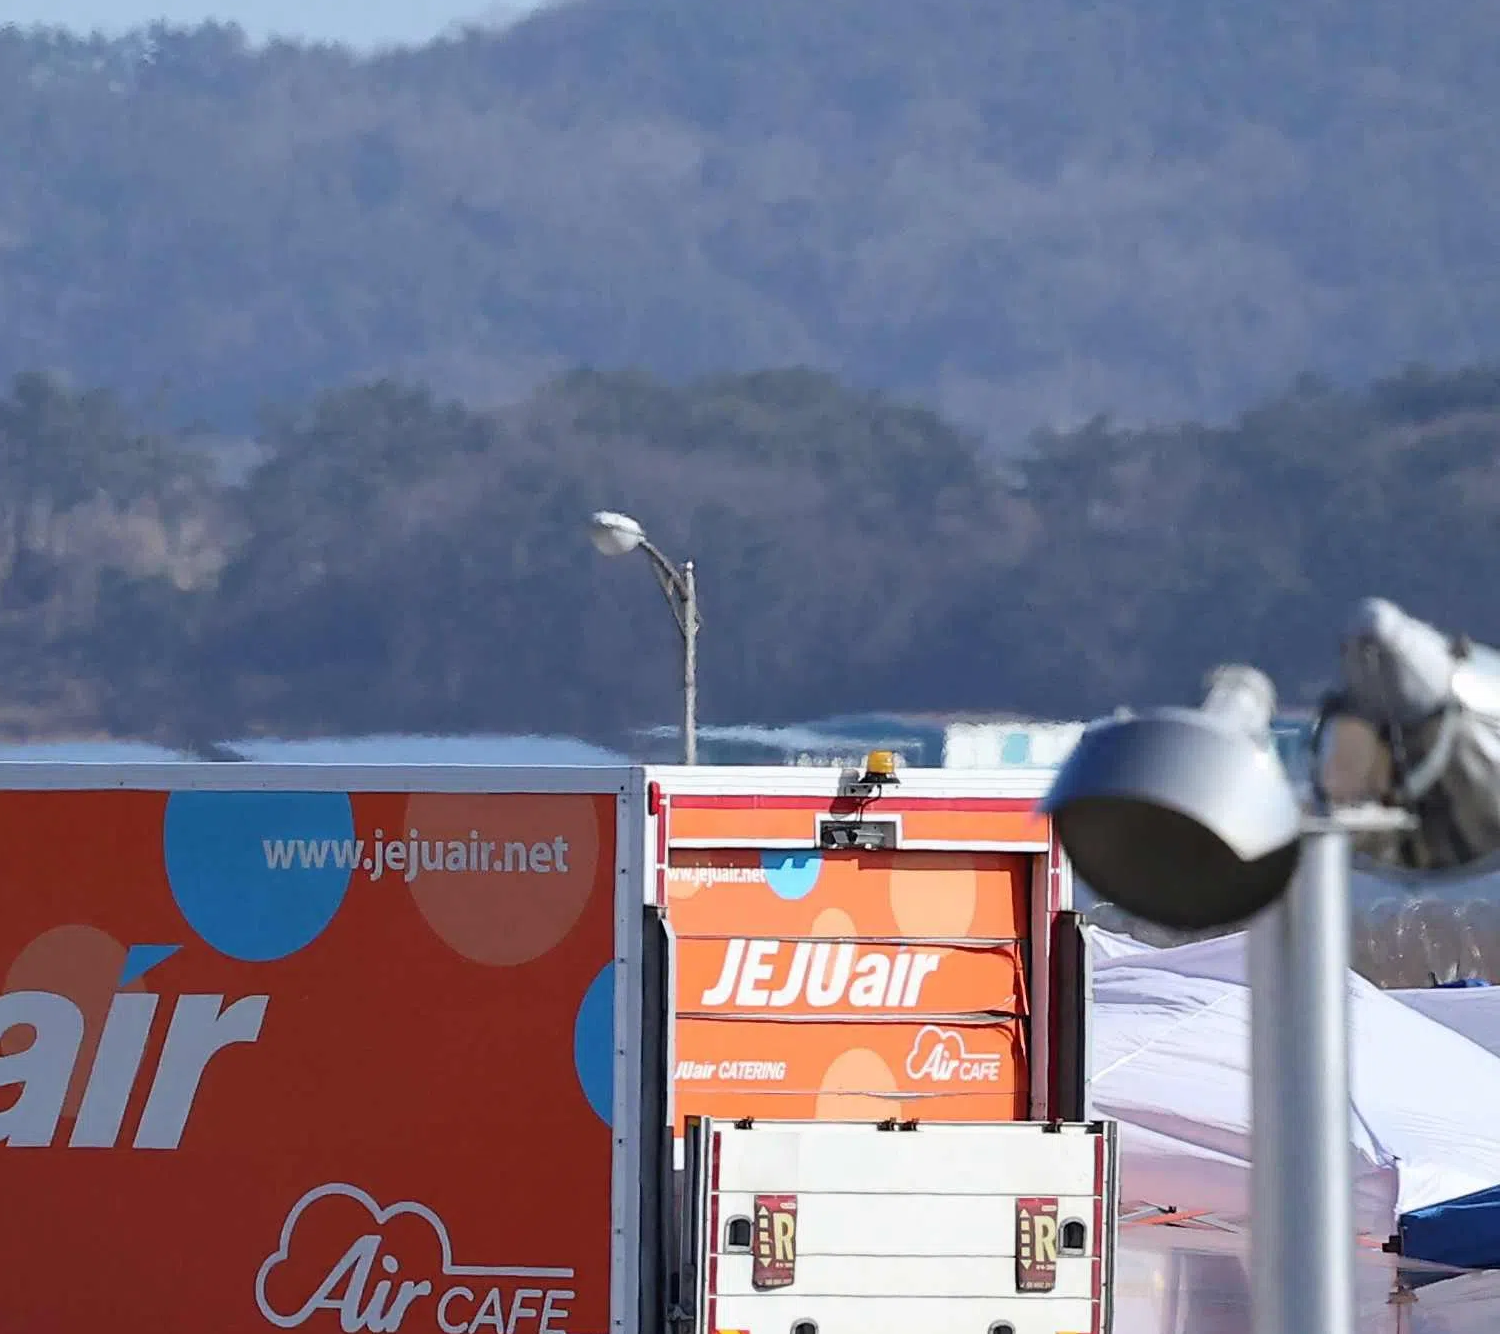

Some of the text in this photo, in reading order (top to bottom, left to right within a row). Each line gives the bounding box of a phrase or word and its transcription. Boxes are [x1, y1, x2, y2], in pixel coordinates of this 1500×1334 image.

[262, 829, 569, 882] www.jejuair.net
[667, 862, 767, 888] ww.jejuair.net
[701, 937, 941, 1007] JEJUair
[718, 1061, 786, 1080] CATERING
[918, 1042, 959, 1079] Air
[960, 1061, 1001, 1081] CAFE
[298, 1234, 432, 1334] Air
